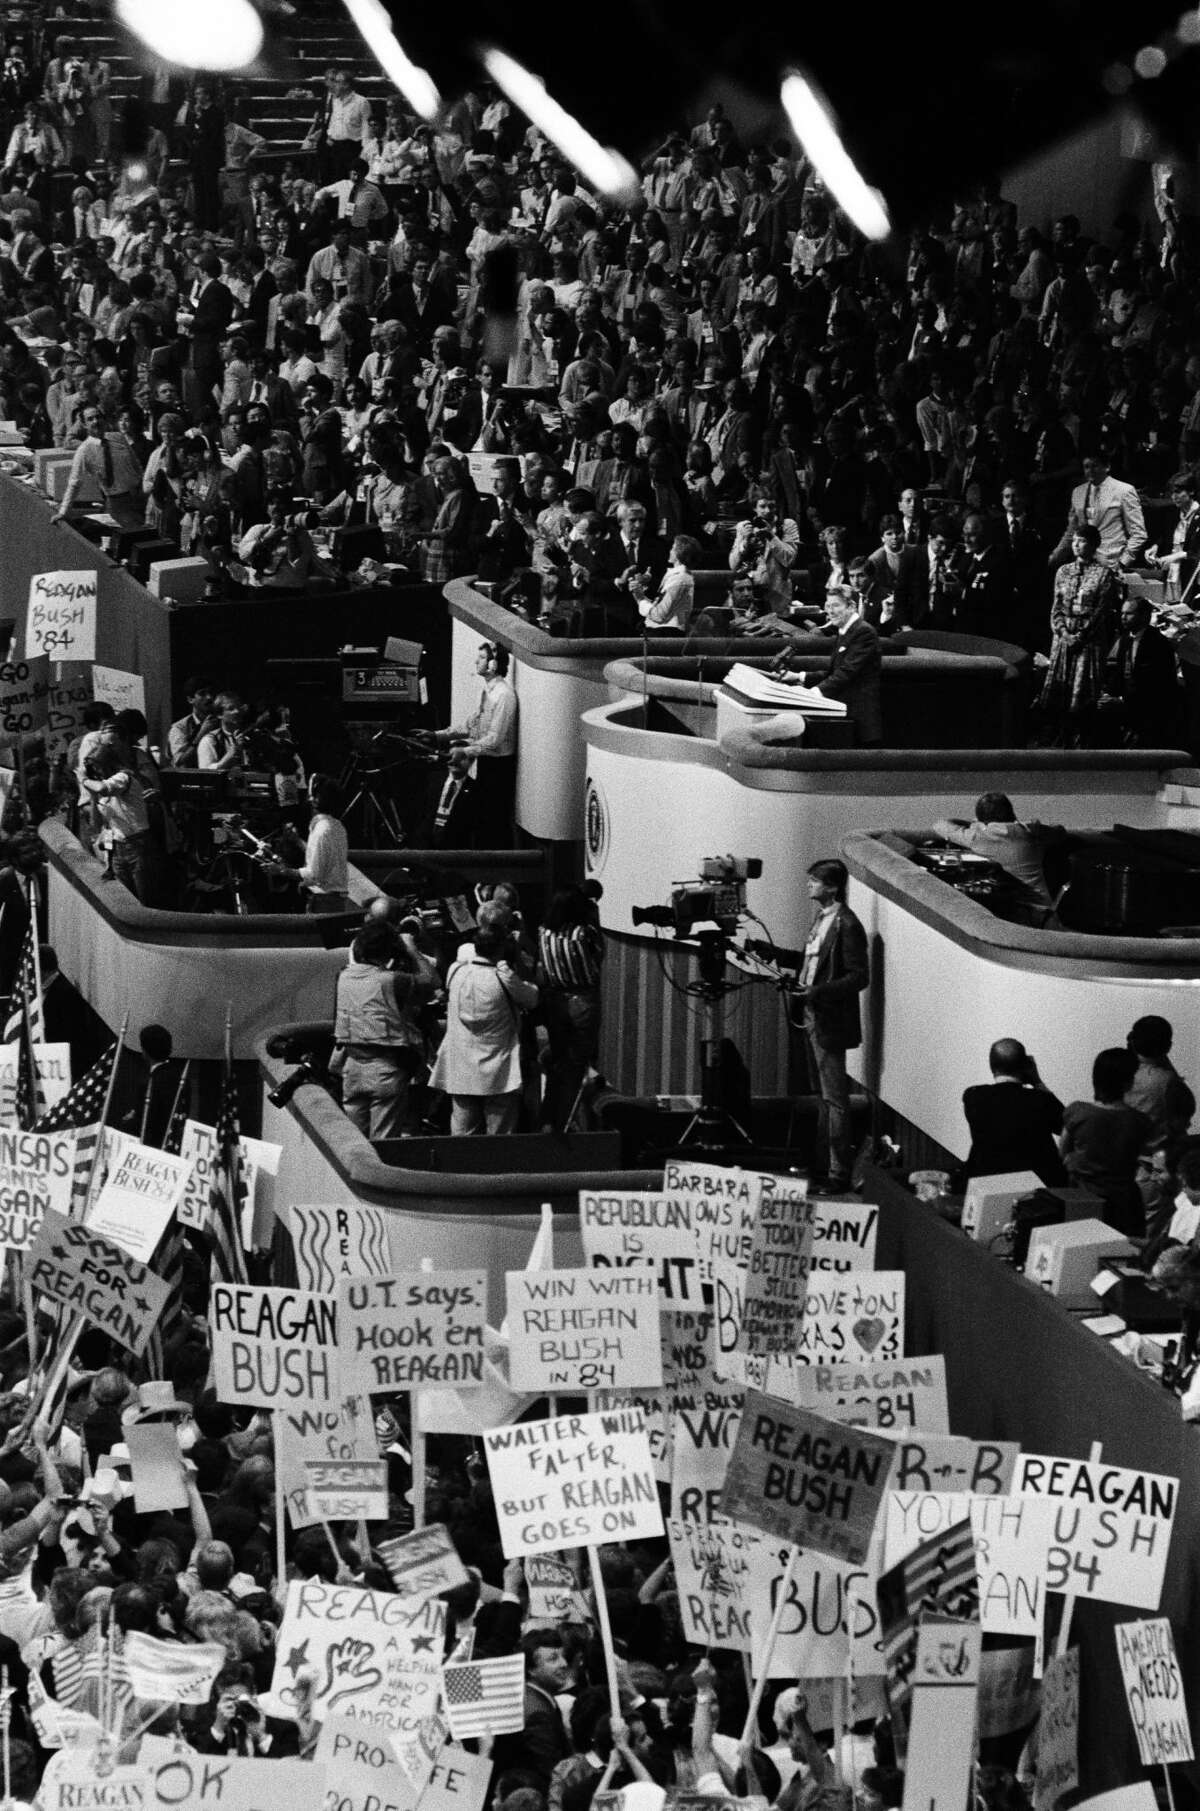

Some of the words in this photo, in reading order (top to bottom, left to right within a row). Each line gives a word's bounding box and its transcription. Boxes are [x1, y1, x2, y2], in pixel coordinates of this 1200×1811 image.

[31, 604, 85, 626] BUSH
[666, 1165, 750, 1202] BARBARA
[584, 1197, 692, 1230] REPUBLICAN
[622, 1233, 644, 1253] IS
[80, 1258, 128, 1300] FOR
[523, 1278, 576, 1300] WIN
[588, 1278, 653, 1296] WITH
[31, 1258, 143, 1350] REAGAN
[214, 1287, 339, 1347] REAGAN
[523, 1308, 638, 1334] REAGAN
[370, 1351, 484, 1386] REAGAN
[540, 1337, 624, 1363] BUSH
[231, 1341, 330, 1401] BUSH
[549, 1371, 569, 1384] IN
[816, 1368, 935, 1393] REAGAN
[487, 1417, 589, 1451] WALTER
[600, 1410, 647, 1436] WILL
[751, 1414, 883, 1487] REAGAN
[502, 1494, 549, 1517] BUT
[561, 1472, 656, 1510] REAGAN
[763, 1462, 854, 1522] BUSH
[1021, 1459, 1175, 1520] REAGAN
[521, 1516, 591, 1544] GOES
[602, 1510, 638, 1533] ON
[296, 1585, 448, 1638] REAGAN
[154, 1760, 231, 1805] OK
